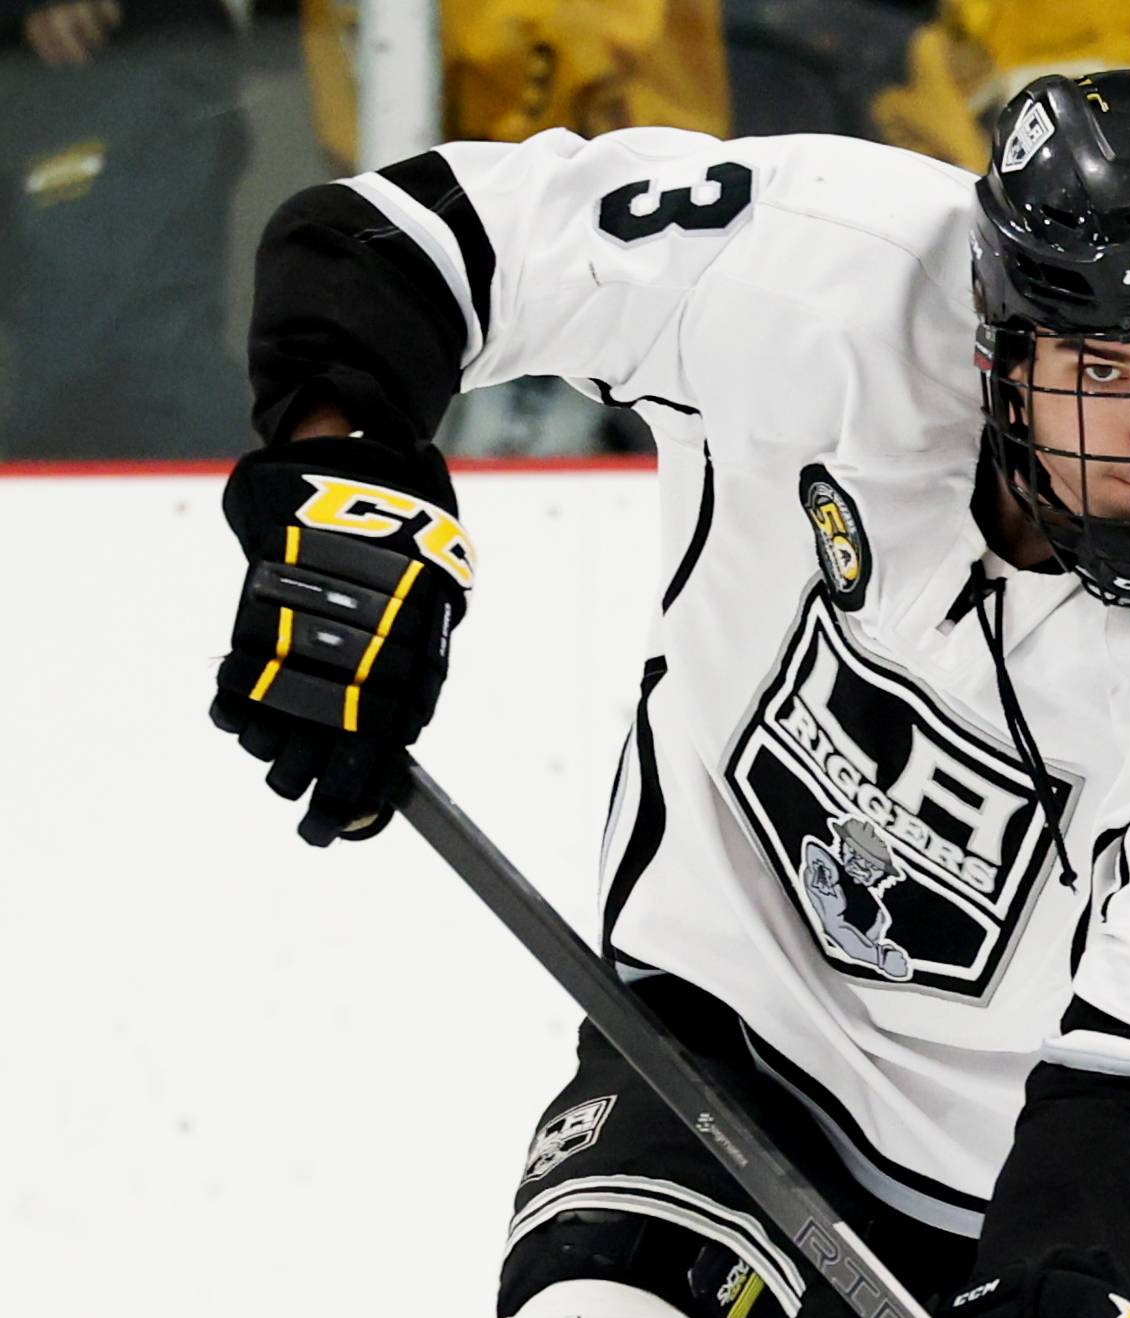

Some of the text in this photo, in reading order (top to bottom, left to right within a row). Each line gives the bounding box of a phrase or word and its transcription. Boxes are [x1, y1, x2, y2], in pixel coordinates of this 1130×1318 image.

[594, 161, 754, 249] 3
[778, 695, 998, 894] RIGGERS
[792, 630, 1029, 866] LA
[953, 1279, 1000, 1307] CCM
